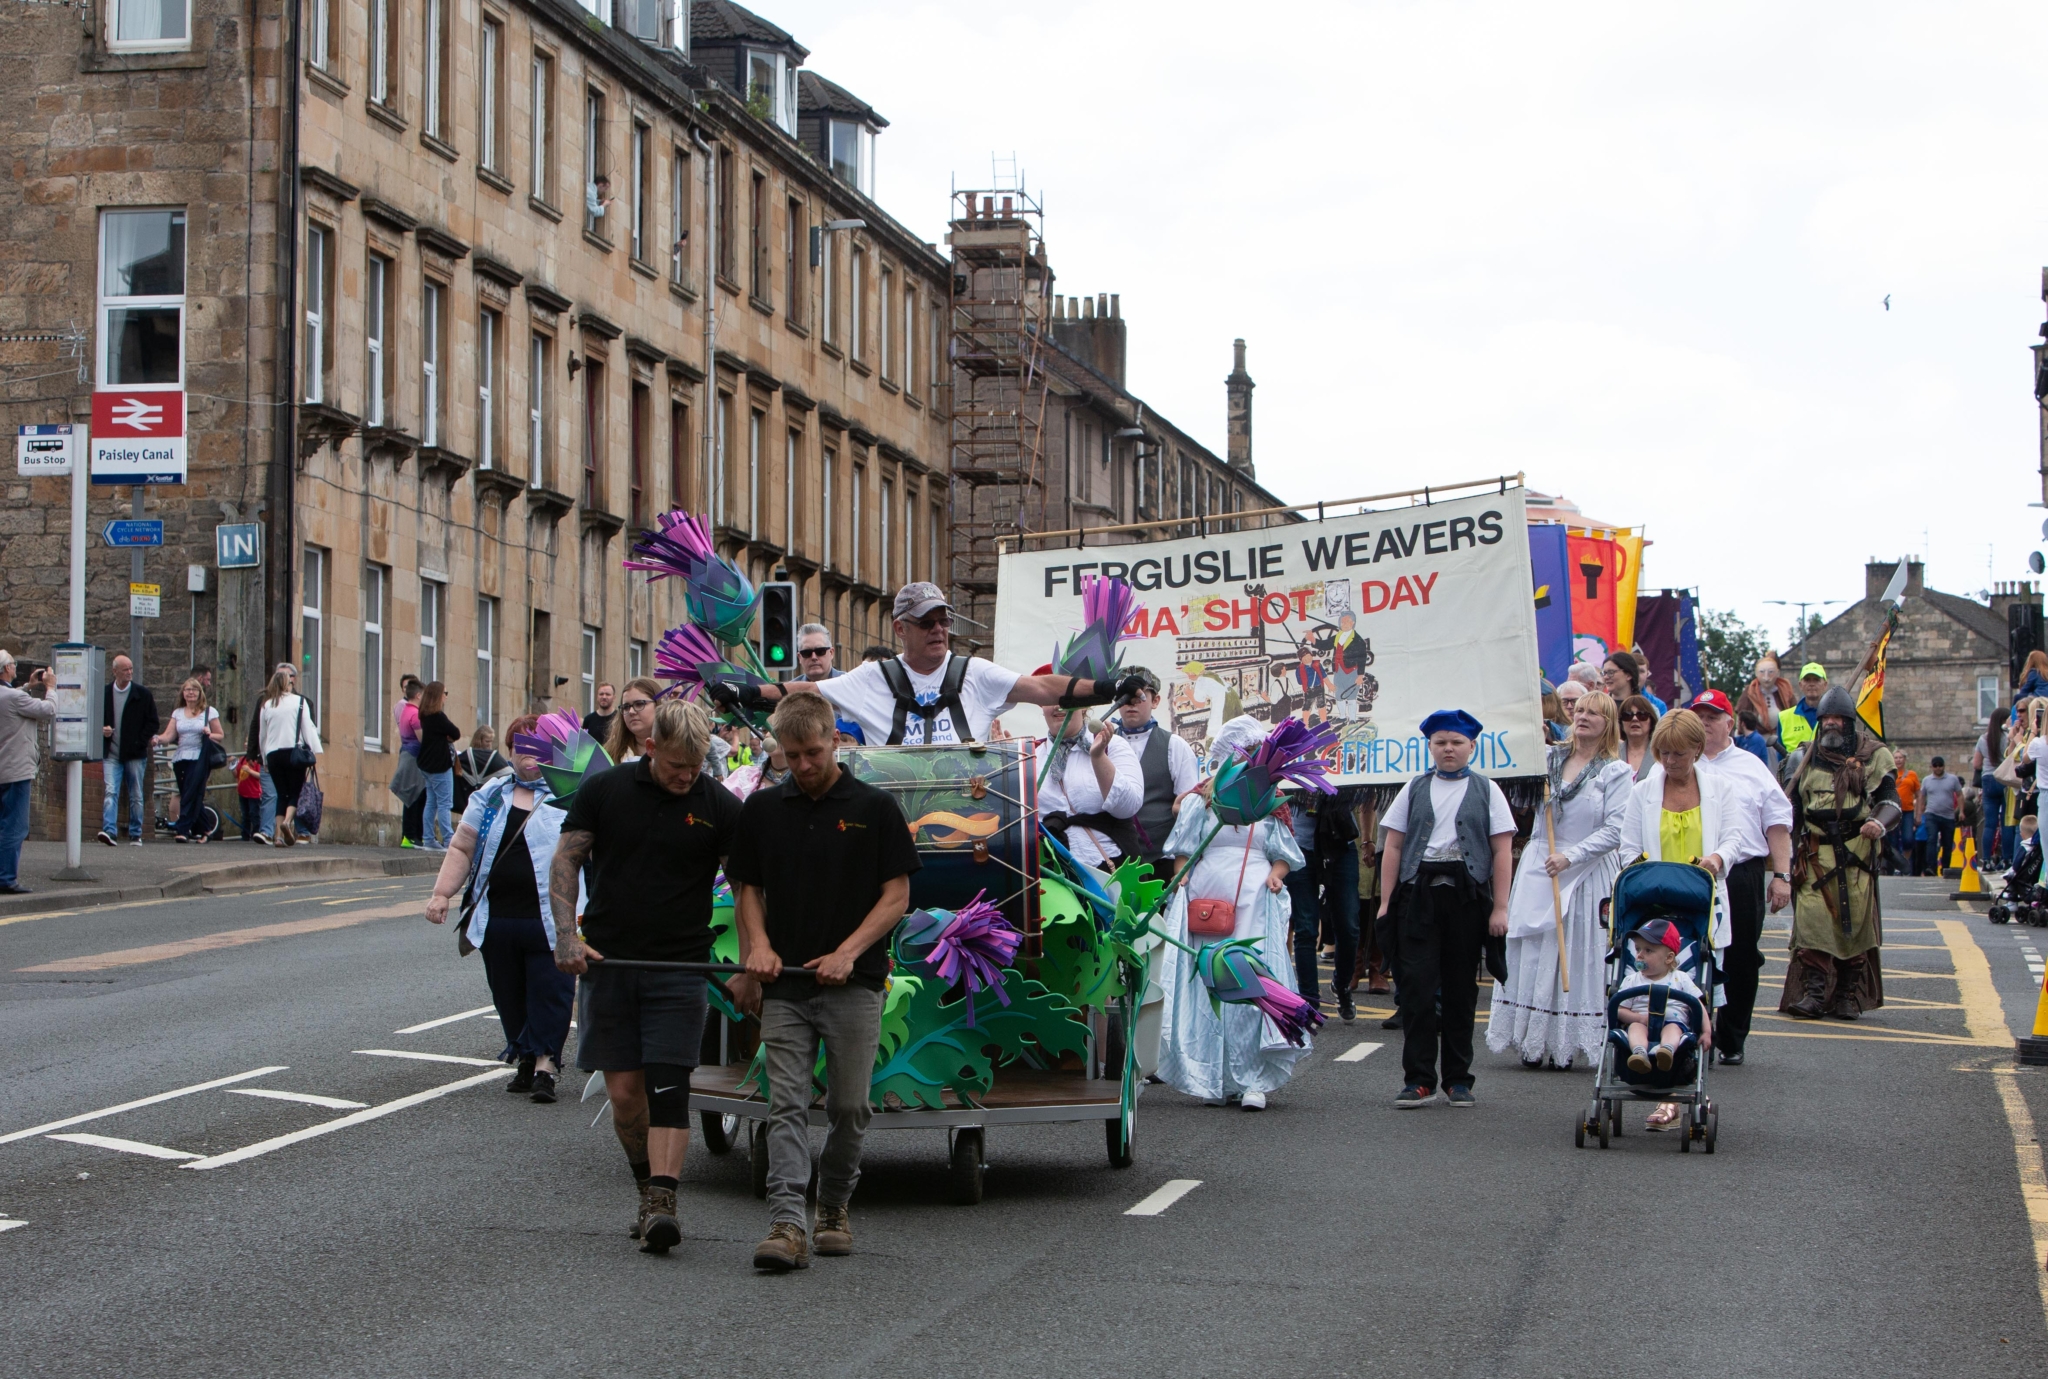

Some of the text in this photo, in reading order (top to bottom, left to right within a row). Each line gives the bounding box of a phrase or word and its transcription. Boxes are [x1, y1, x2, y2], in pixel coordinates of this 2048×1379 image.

[24, 456, 66, 465] Bus Stop
[99, 448, 174, 463] Paisley Canal
[223, 533, 253, 558] IN
[1302, 510, 1504, 572] WEAVERS
[1114, 571, 1439, 638] MA' SHOT DAY
[903, 733, 953, 745] Scoand
[1320, 730, 1518, 776] GENERATNS.
